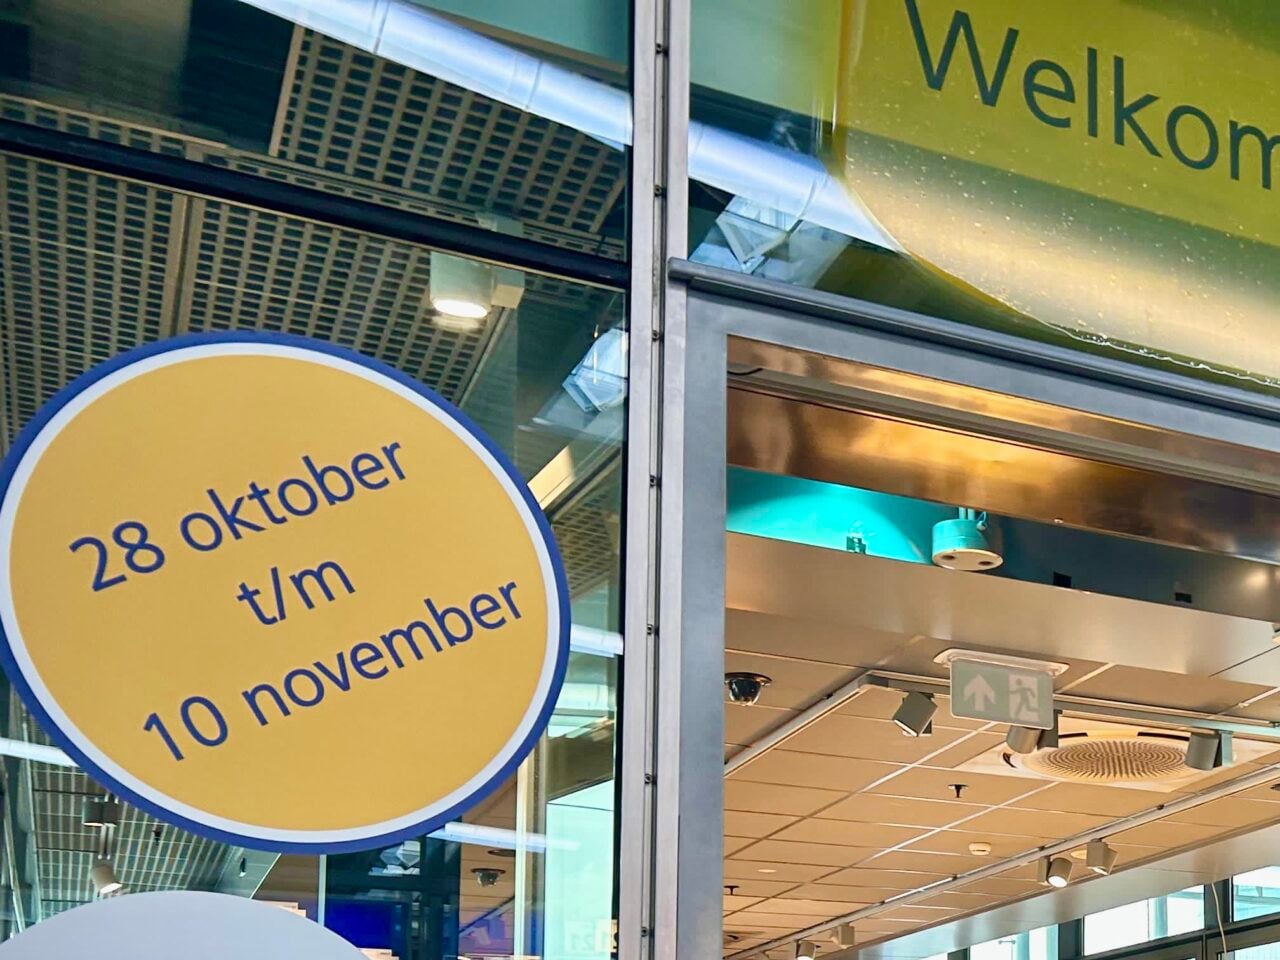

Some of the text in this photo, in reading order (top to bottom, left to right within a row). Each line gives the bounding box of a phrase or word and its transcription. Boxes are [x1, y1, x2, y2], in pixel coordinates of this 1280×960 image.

[68, 441, 407, 592] 28 oktober
[237, 559, 356, 625] t/m
[143, 581, 522, 762] 10 november
